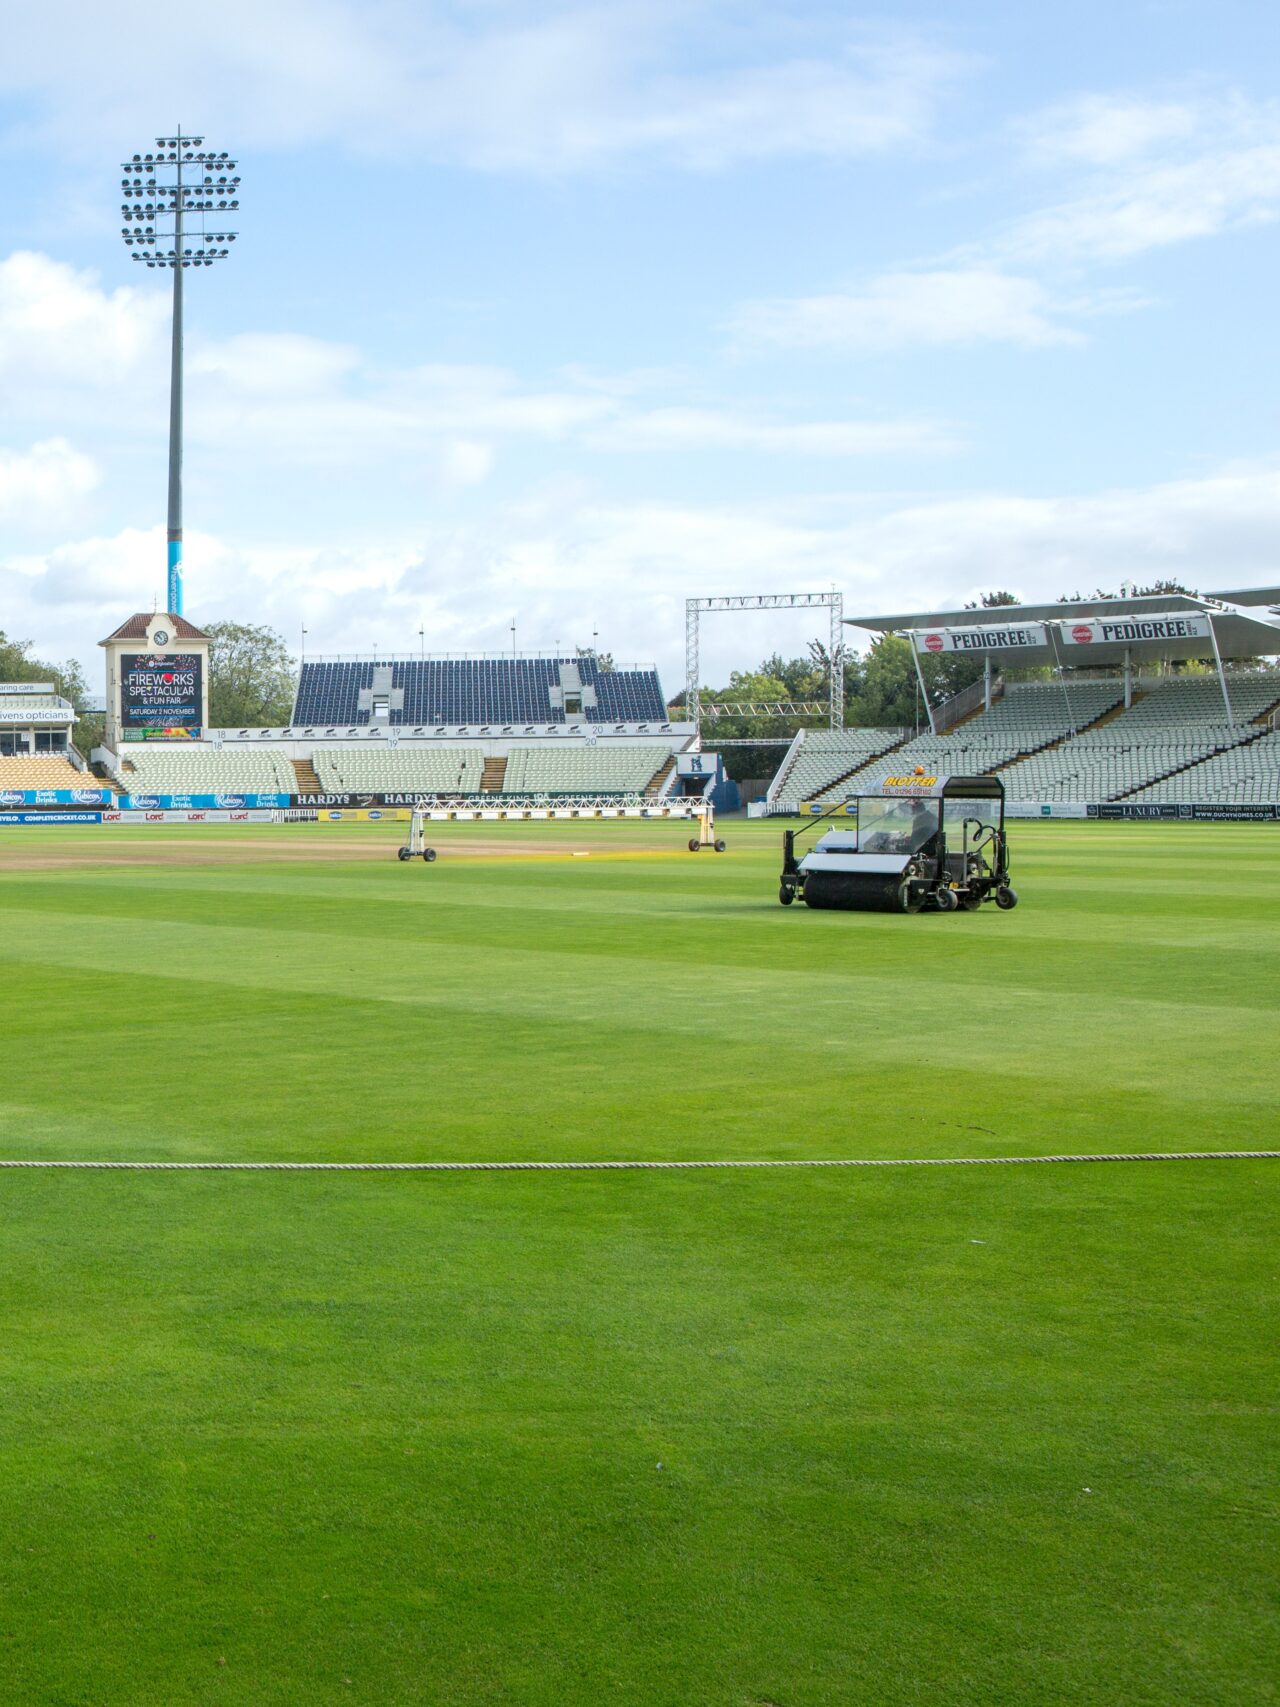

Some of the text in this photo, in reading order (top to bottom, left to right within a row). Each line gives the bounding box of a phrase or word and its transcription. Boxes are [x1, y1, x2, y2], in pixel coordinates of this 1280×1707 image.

[1101, 621, 1186, 640] PEDIGREE
[952, 631, 1026, 649] PEDIGREE
[26, 711, 68, 721] opticians
[218, 730, 226, 738] 18
[392, 728, 400, 736] 19
[592, 726, 603, 734] 20
[214, 742, 222, 750] 18
[388, 740, 398, 748] 19
[586, 738, 596, 746] 20
[883, 776, 937, 786] BLOTTER
[72, 791, 100, 802] Rubicon
[130, 796, 158, 807] Rubicon
[216, 795, 243, 807] Rubicon
[298, 794, 350, 804] HARDYS
[384, 794, 438, 804] HARDYS
[1123, 807, 1162, 815] LUXURY
